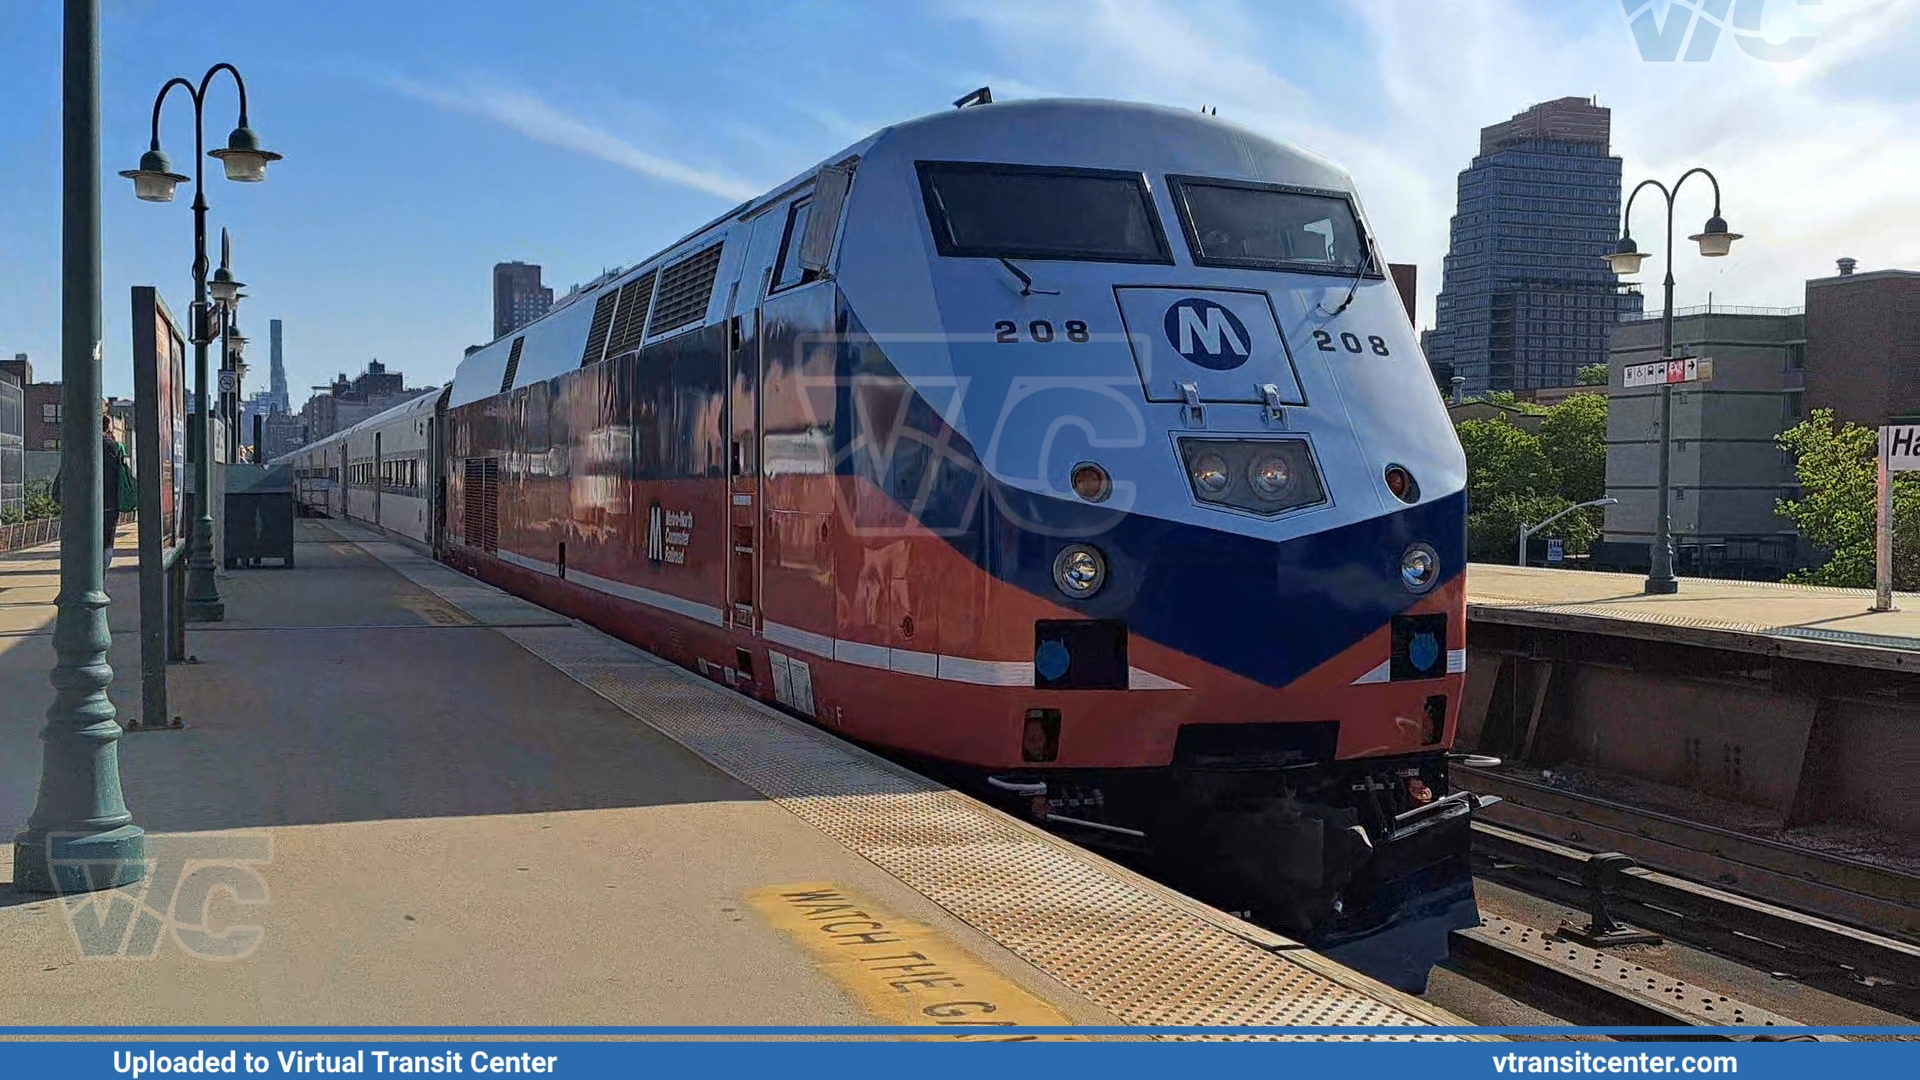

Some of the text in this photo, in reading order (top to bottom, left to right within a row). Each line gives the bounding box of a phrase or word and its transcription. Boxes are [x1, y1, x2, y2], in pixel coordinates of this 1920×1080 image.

[994, 319, 1090, 344] 208
[1177, 306, 1249, 356] M
[1312, 329, 1390, 357] 208
[781, 889, 902, 946] WATCH
[858, 951, 964, 993] THE
